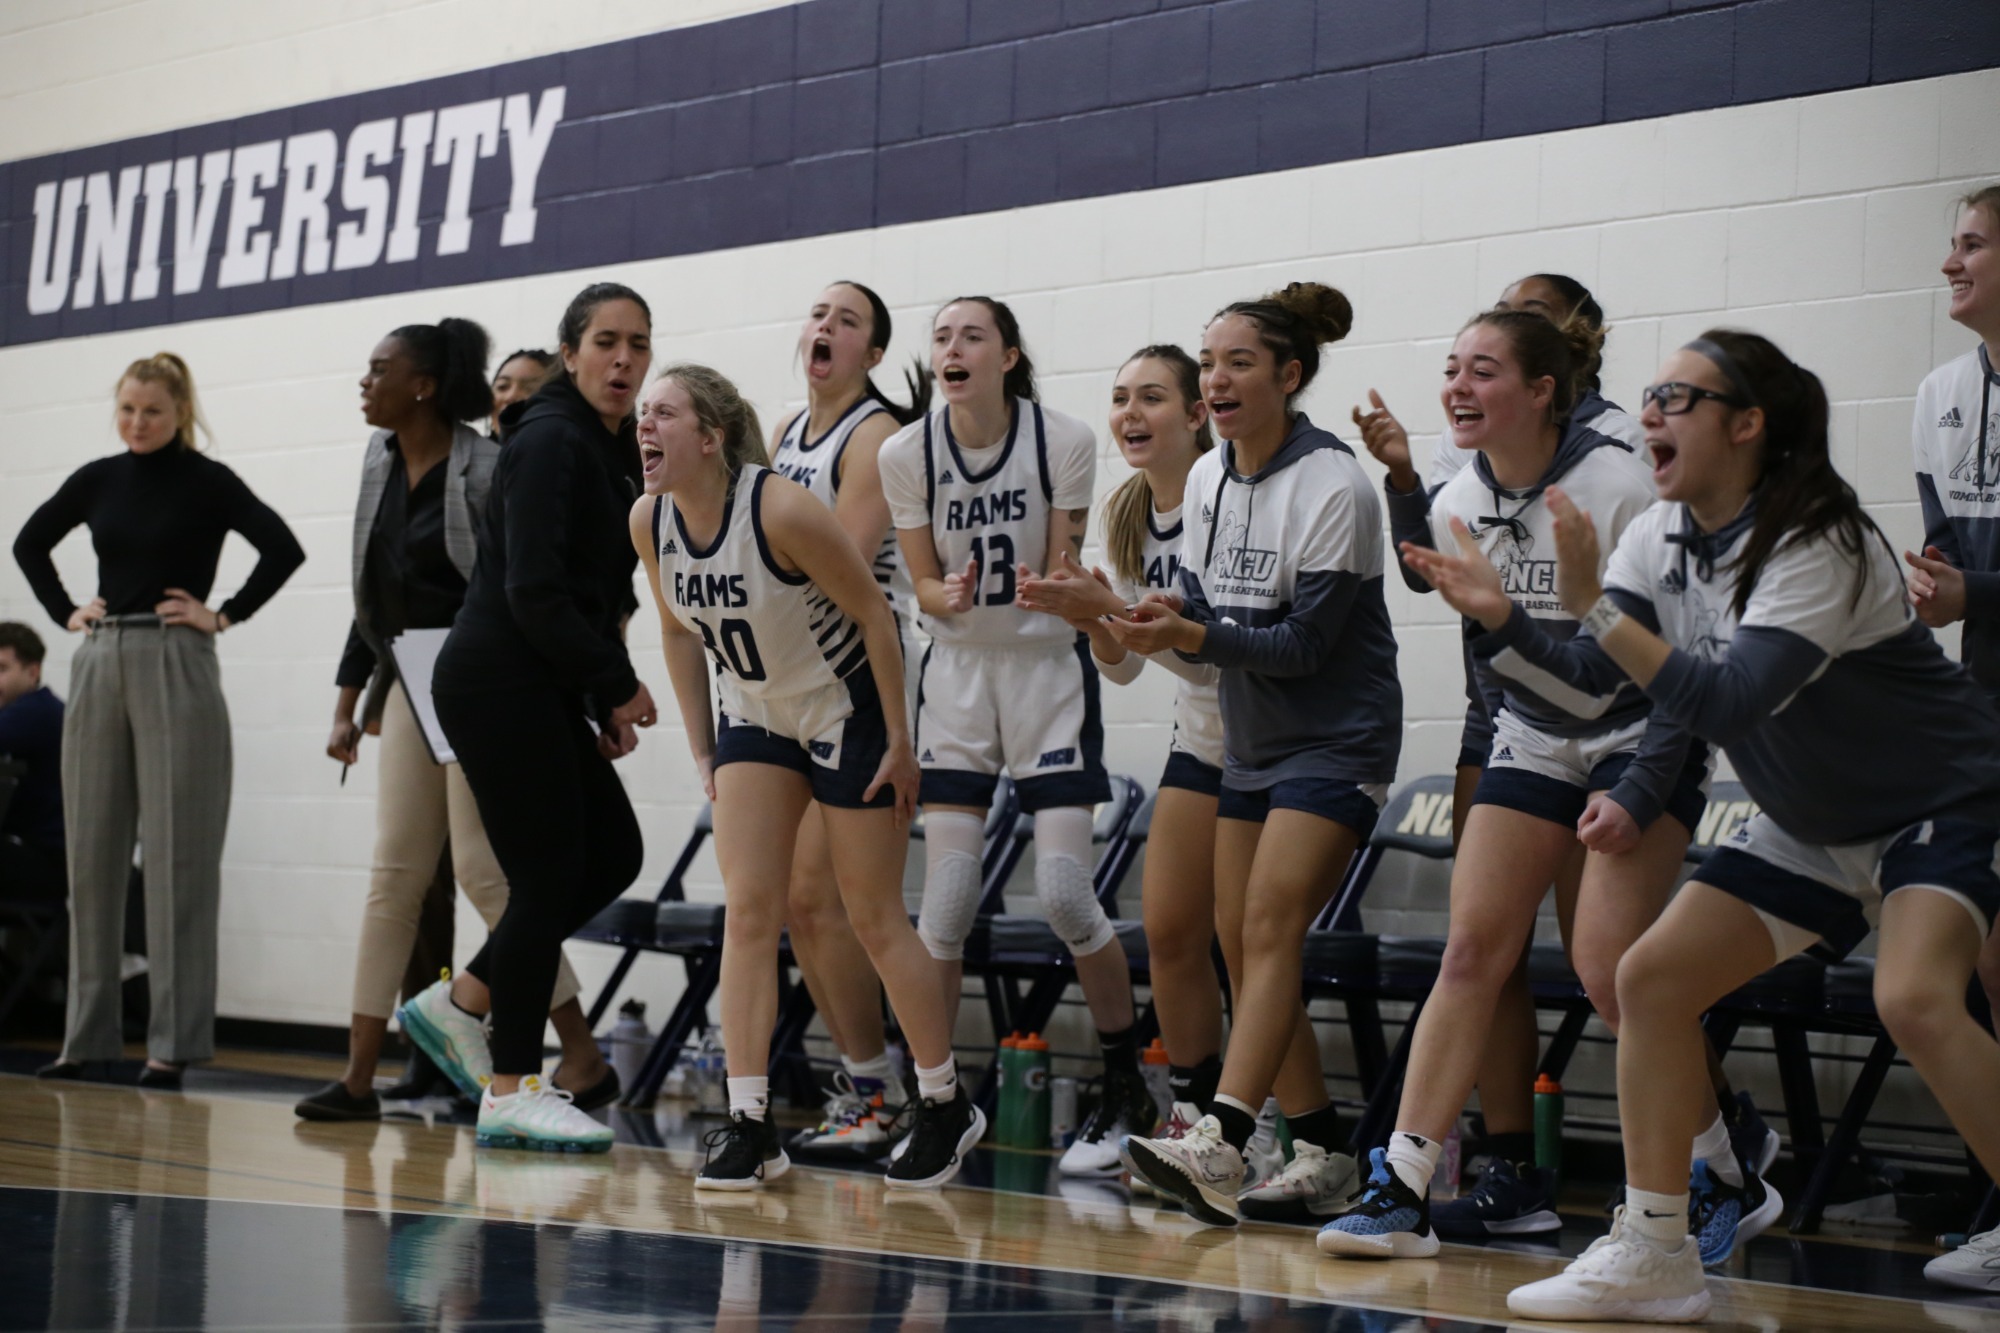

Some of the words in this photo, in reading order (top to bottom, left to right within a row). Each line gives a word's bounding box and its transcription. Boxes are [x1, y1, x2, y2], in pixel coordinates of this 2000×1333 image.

[27, 86, 566, 315] UNIVERSITY
[946, 488, 1027, 531] RAMS
[674, 572, 748, 608] RAMS
[970, 533, 1016, 606] 13
[1139, 553, 1182, 588] AM
[1525, 600, 1569, 611] BASKET
[1396, 792, 1454, 837] NC
